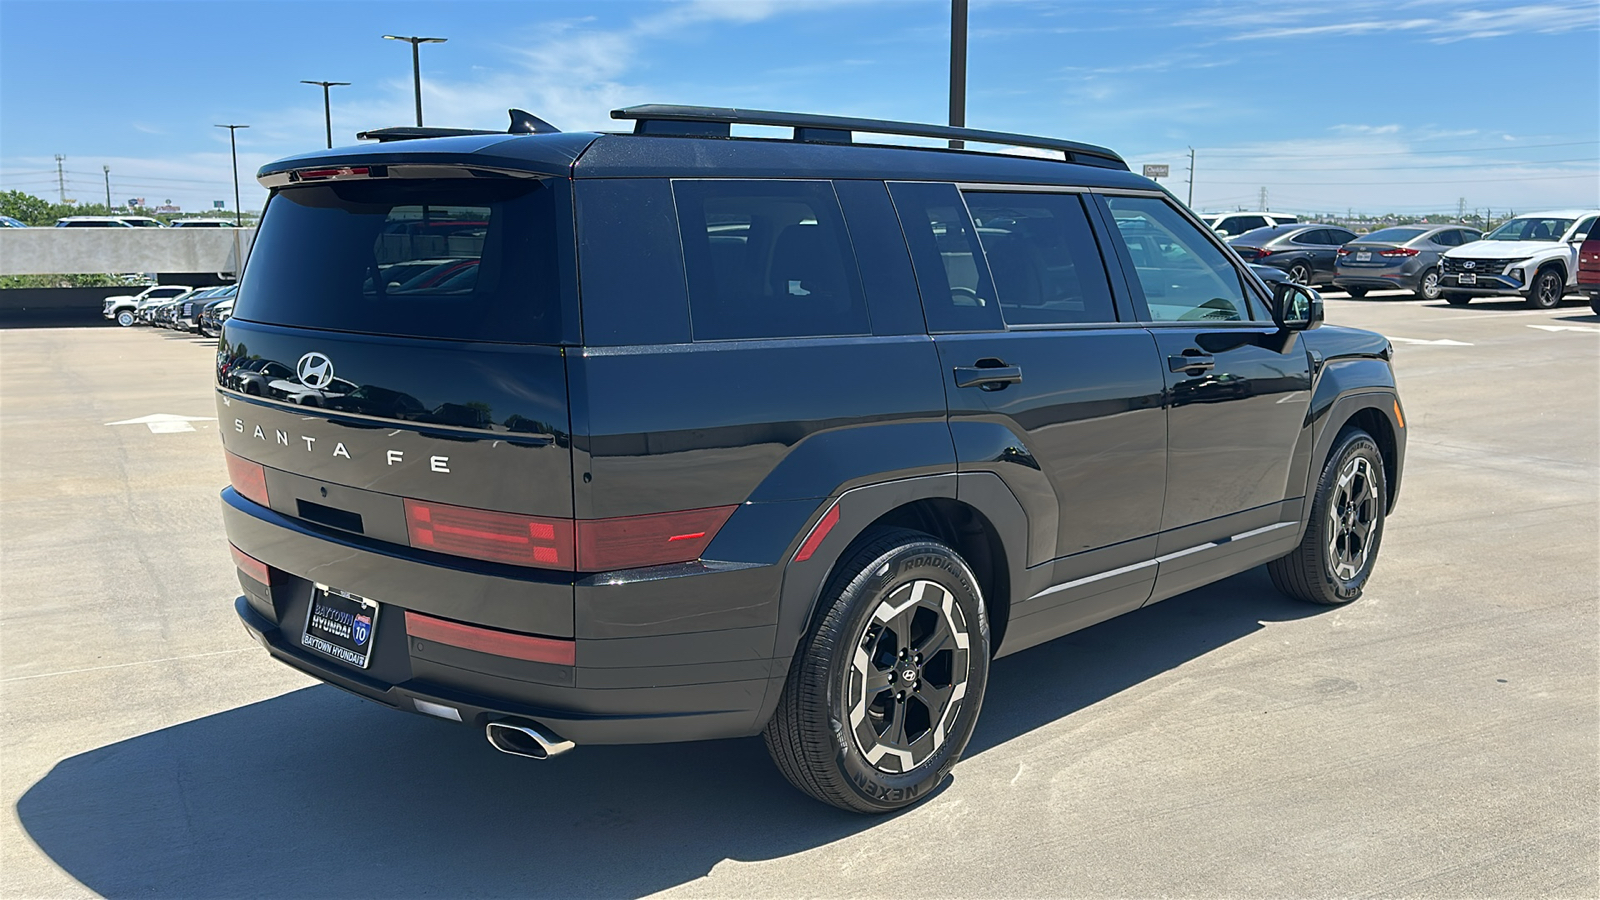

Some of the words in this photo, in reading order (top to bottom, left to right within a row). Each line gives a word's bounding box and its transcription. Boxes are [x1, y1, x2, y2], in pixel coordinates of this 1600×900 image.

[234, 418, 351, 460] SANTA
[387, 449, 451, 474] FE
[904, 556, 962, 579] ROADIAN
[311, 615, 352, 639] HYUNDAI
[314, 604, 354, 626] BAYTOWN
[355, 626, 366, 641] 10
[304, 635, 332, 654] BAYTOWN
[331, 646, 360, 664] HYUNDAI
[853, 771, 918, 801] NEXEN
